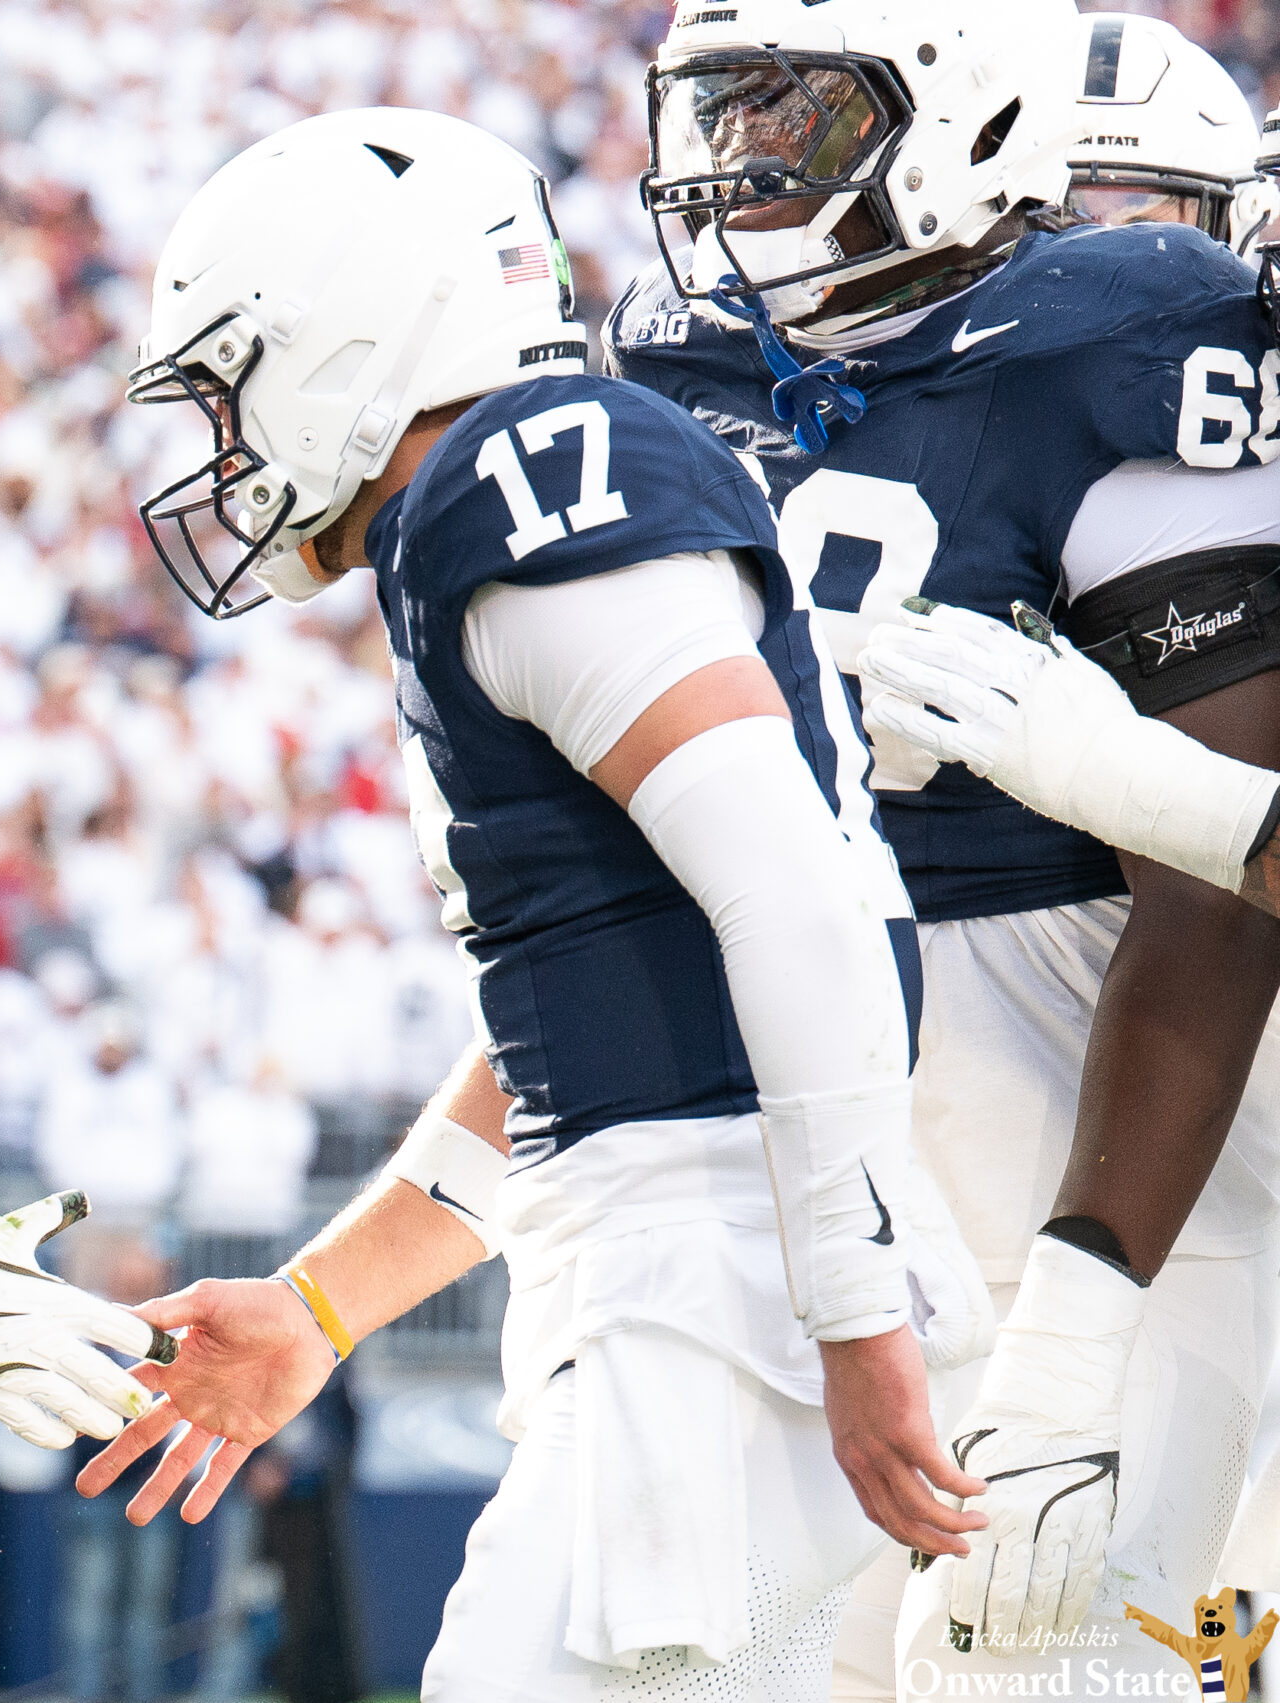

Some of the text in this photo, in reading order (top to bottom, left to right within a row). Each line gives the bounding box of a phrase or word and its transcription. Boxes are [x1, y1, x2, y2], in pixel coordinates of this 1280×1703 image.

[701, 10, 738, 23] STATE
[1097, 136, 1139, 147] STATE
[475, 400, 629, 562] 17
[733, 452, 940, 791] 8
[1170, 610, 1242, 644] Douglas
